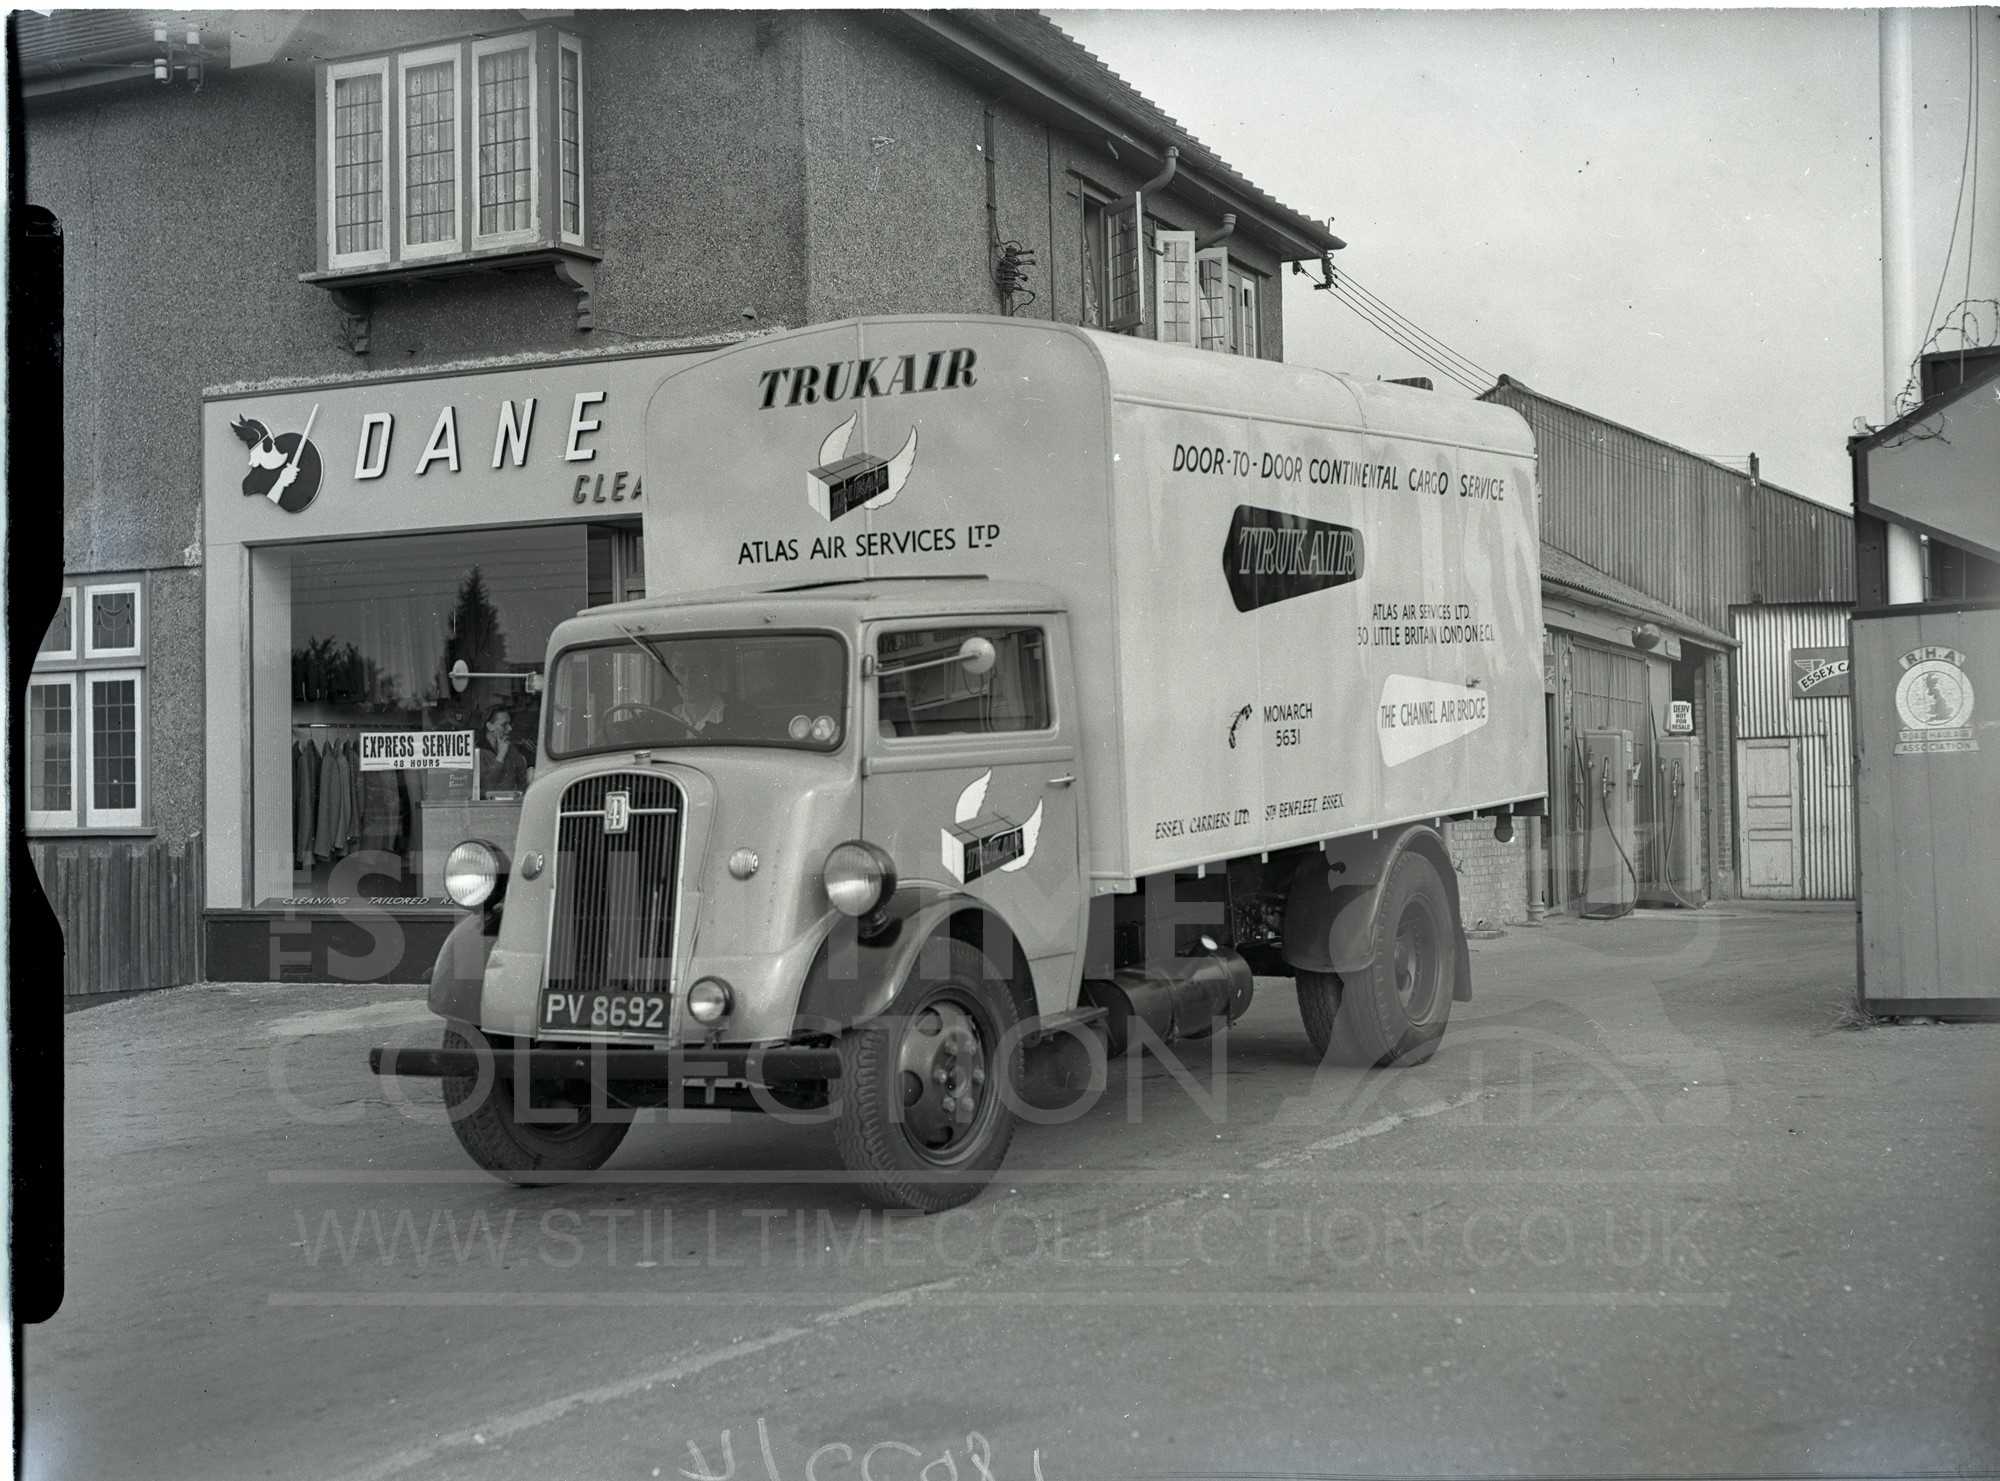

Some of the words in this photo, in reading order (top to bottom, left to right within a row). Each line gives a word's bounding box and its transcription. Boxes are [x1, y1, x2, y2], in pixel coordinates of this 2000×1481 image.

[758, 347, 978, 411] TRUKAIR
[354, 391, 608, 480] DANE
[1309, 458, 1399, 492] CONTINENTAL
[1408, 467, 1449, 496] CARGO
[1460, 473, 1505, 502] SERVICE
[738, 537, 800, 566] ATLAS
[810, 535, 848, 561] AIR
[855, 526, 957, 558] SERVICES
[967, 523, 1001, 549] LTD
[1239, 525, 1357, 576] TRUKAIR
[1372, 603, 1398, 621] ATLAS
[1402, 603, 1417, 621] AIR
[1419, 603, 1451, 621] SERVICES
[1373, 626, 1401, 647] LITTLE
[1404, 626, 1437, 646] BRITAIN
[1440, 624, 1479, 645] LONDON
[1800, 664, 1836, 689] ESSEX
[1263, 703, 1314, 724] MONARCH
[1381, 704, 1396, 729] THE
[1400, 701, 1438, 727] CHANNEL
[1440, 699, 1456, 723] AIR
[1457, 697, 1486, 722] BRIDGE
[1673, 704, 1690, 713] DERV
[363, 735, 415, 759] EXPRESS
[422, 733, 471, 757] SERVICE
[1275, 729, 1302, 748] 5631
[1902, 742, 1972, 753] ASSOCIATION
[393, 759, 405, 768] 48
[410, 759, 441, 768] HOURS
[1155, 819, 1185, 840] ESSEX
[1189, 811, 1231, 835] CARRIERS
[1321, 791, 1345, 812] ESSEX
[281, 896, 351, 905] CLEANING
[368, 896, 430, 905] TAILORED
[545, 993, 584, 1024] PV
[591, 996, 665, 1029] 8692
